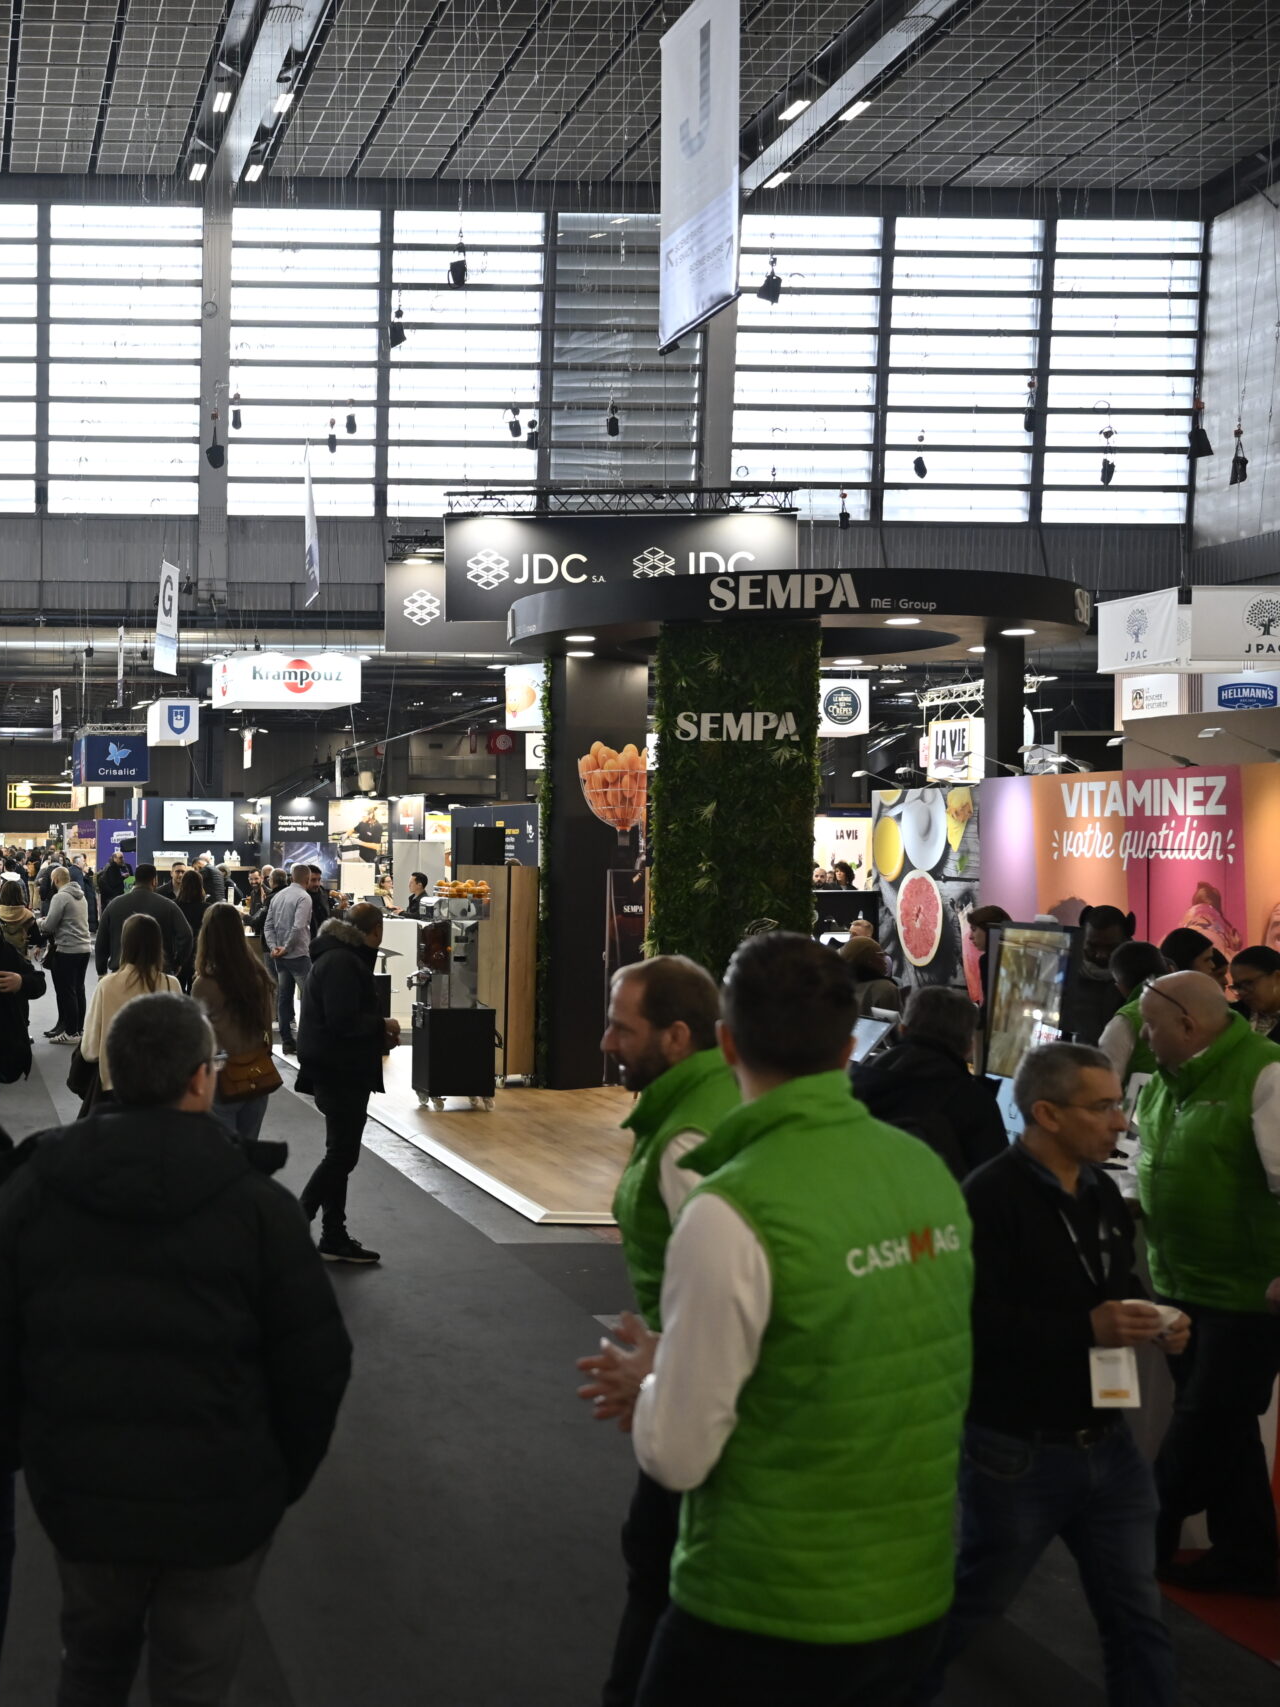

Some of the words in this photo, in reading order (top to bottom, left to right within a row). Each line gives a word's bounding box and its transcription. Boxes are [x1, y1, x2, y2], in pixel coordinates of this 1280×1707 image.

[679, 18, 711, 158] J
[514, 554, 587, 583] JDC
[162, 574, 174, 618] G
[709, 573, 860, 611] SEMPA
[898, 598, 937, 611] Group
[1124, 649, 1148, 661] JPAC
[252, 665, 343, 687] Krampouz
[1221, 687, 1274, 701] HELLMANN'S
[675, 711, 801, 742] SEMPA
[935, 729, 947, 760] LA
[949, 727, 966, 758] VIE
[98, 767, 136, 776] Crisalid
[1061, 776, 1227, 818] VITAMINEZ
[835, 829, 845, 840] LA
[846, 829, 859, 840] VIE
[1062, 821, 1116, 859] votre
[1119, 816, 1224, 871] quotidien
[623, 905, 644, 914] SEMPA
[846, 1224, 960, 1276] CASHMAG
